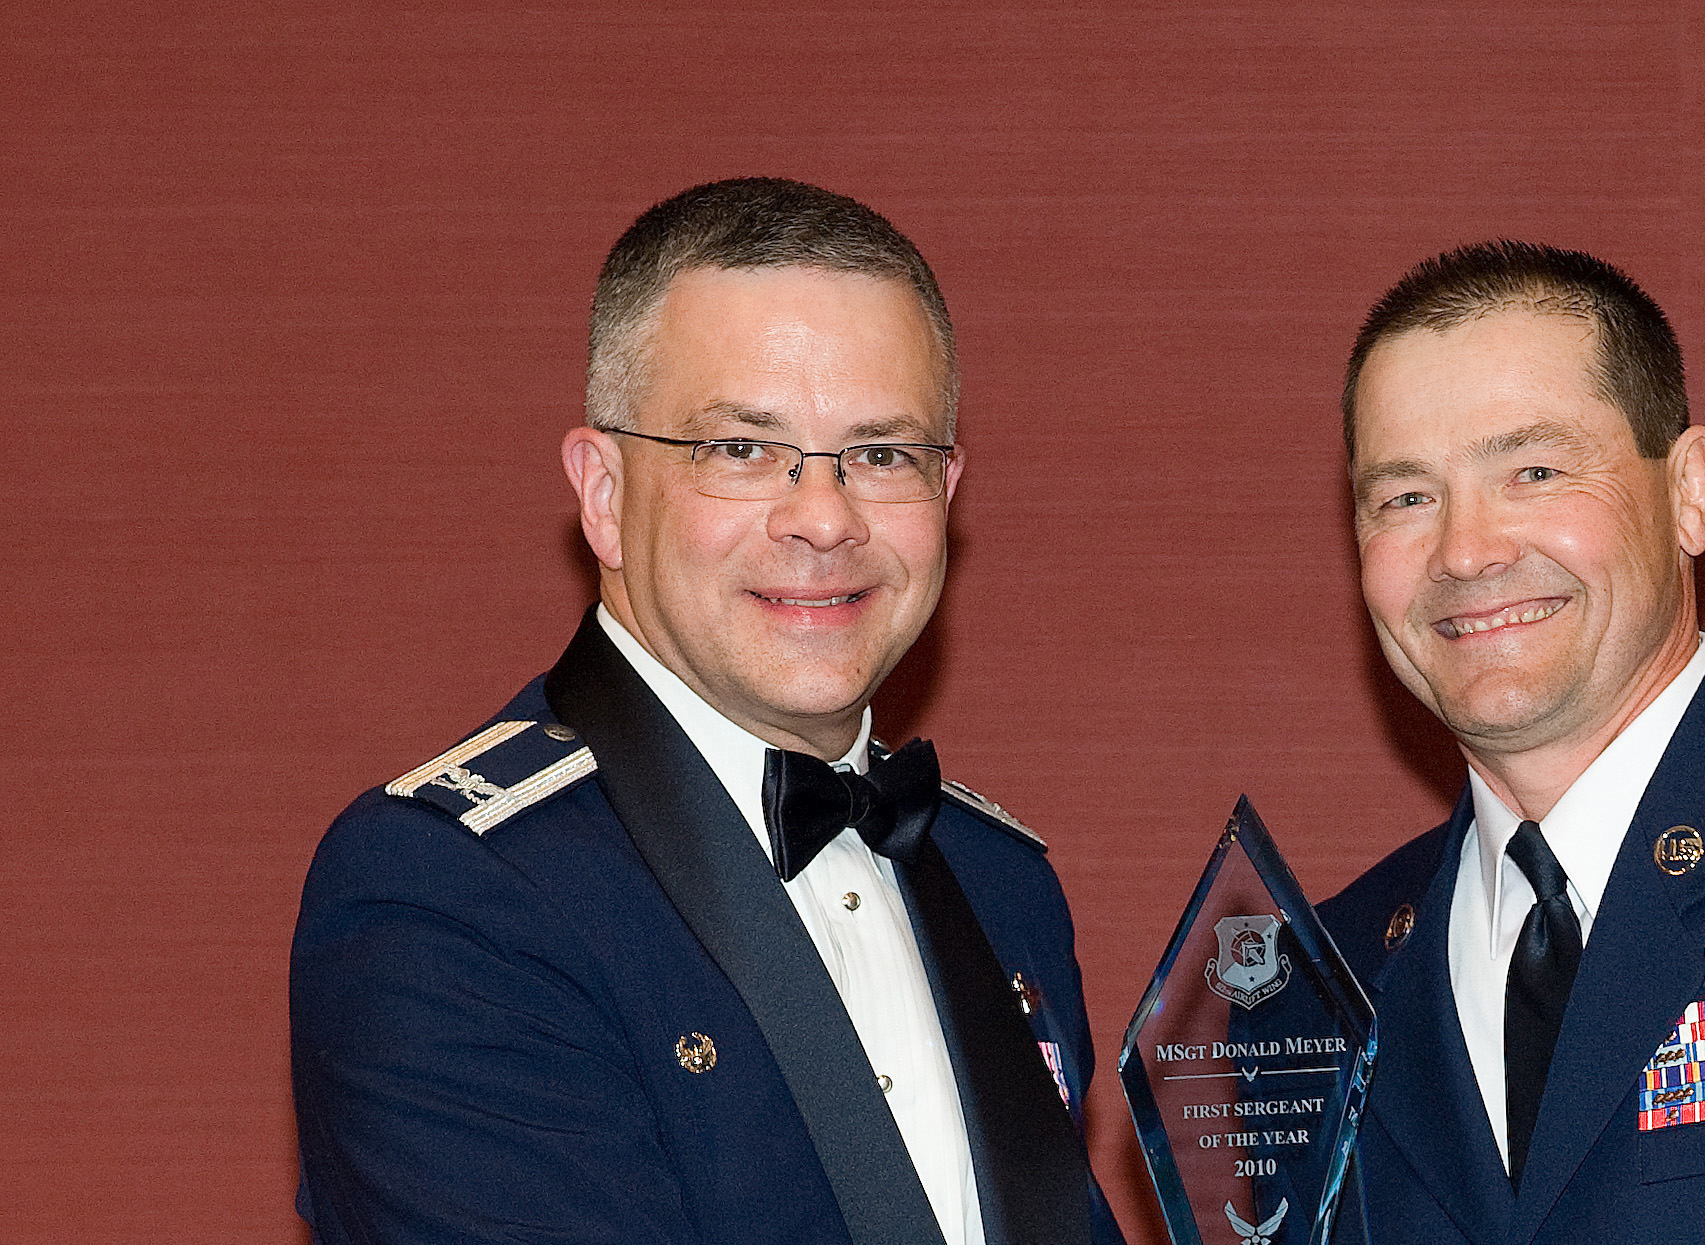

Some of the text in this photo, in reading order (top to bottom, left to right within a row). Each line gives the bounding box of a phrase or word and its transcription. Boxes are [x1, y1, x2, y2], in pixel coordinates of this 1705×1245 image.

[1262, 978, 1283, 995] WING
[1183, 1098, 1324, 1119] FIRST SERGEANT
[1199, 1129, 1309, 1149] OF THE YEAR
[1234, 1158, 1277, 1177] 2010
